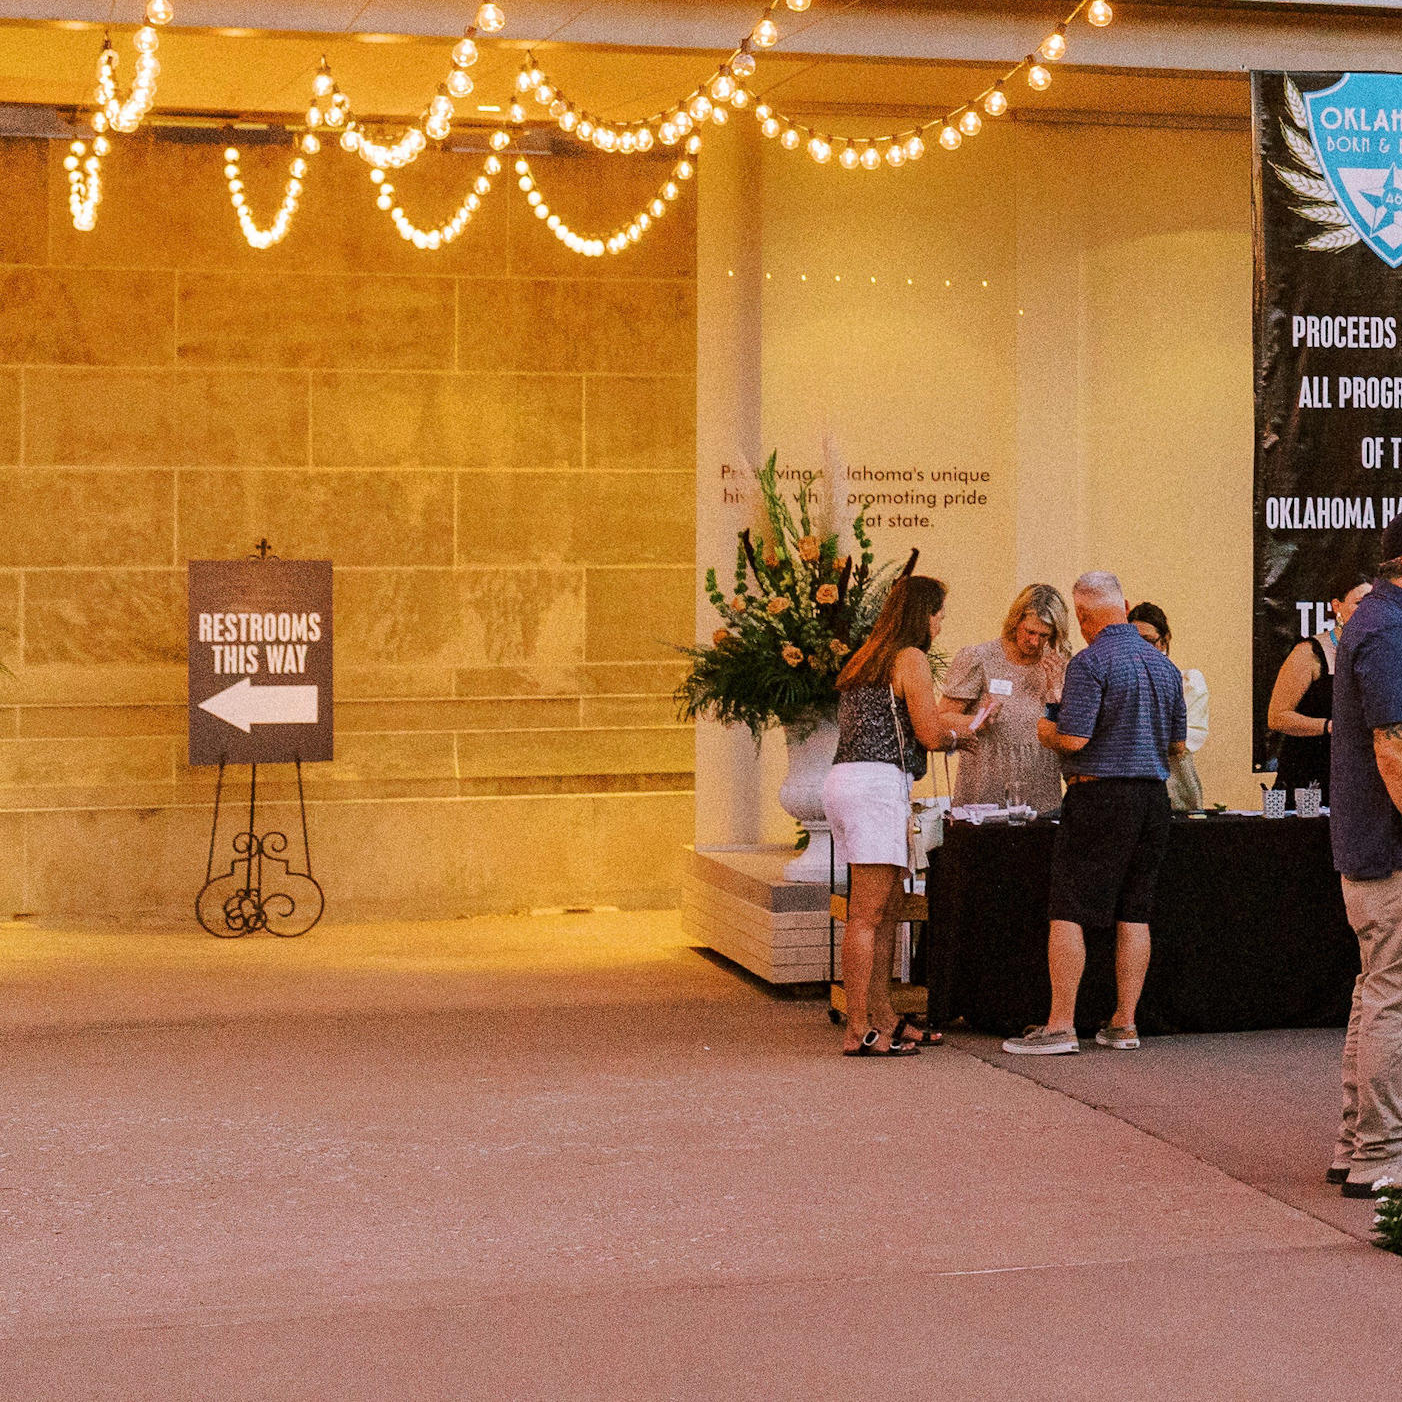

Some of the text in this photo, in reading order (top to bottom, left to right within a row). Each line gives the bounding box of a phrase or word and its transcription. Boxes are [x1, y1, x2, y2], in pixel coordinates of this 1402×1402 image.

[1327, 136, 1370, 153] BORN
[1378, 138, 1391, 154] &
[1292, 315, 1397, 348] PROCEEDS
[1299, 376, 1332, 409] ALL
[1361, 436, 1384, 469] OF
[847, 466, 925, 482] lahoma's
[931, 467, 991, 485] unique
[847, 489, 988, 508] promoting pride
[1265, 497, 1376, 529] OKLAHOMA
[888, 514, 934, 528] state.
[199, 612, 322, 643] RESTROOMS
[211, 644, 310, 675] THIS WAY
